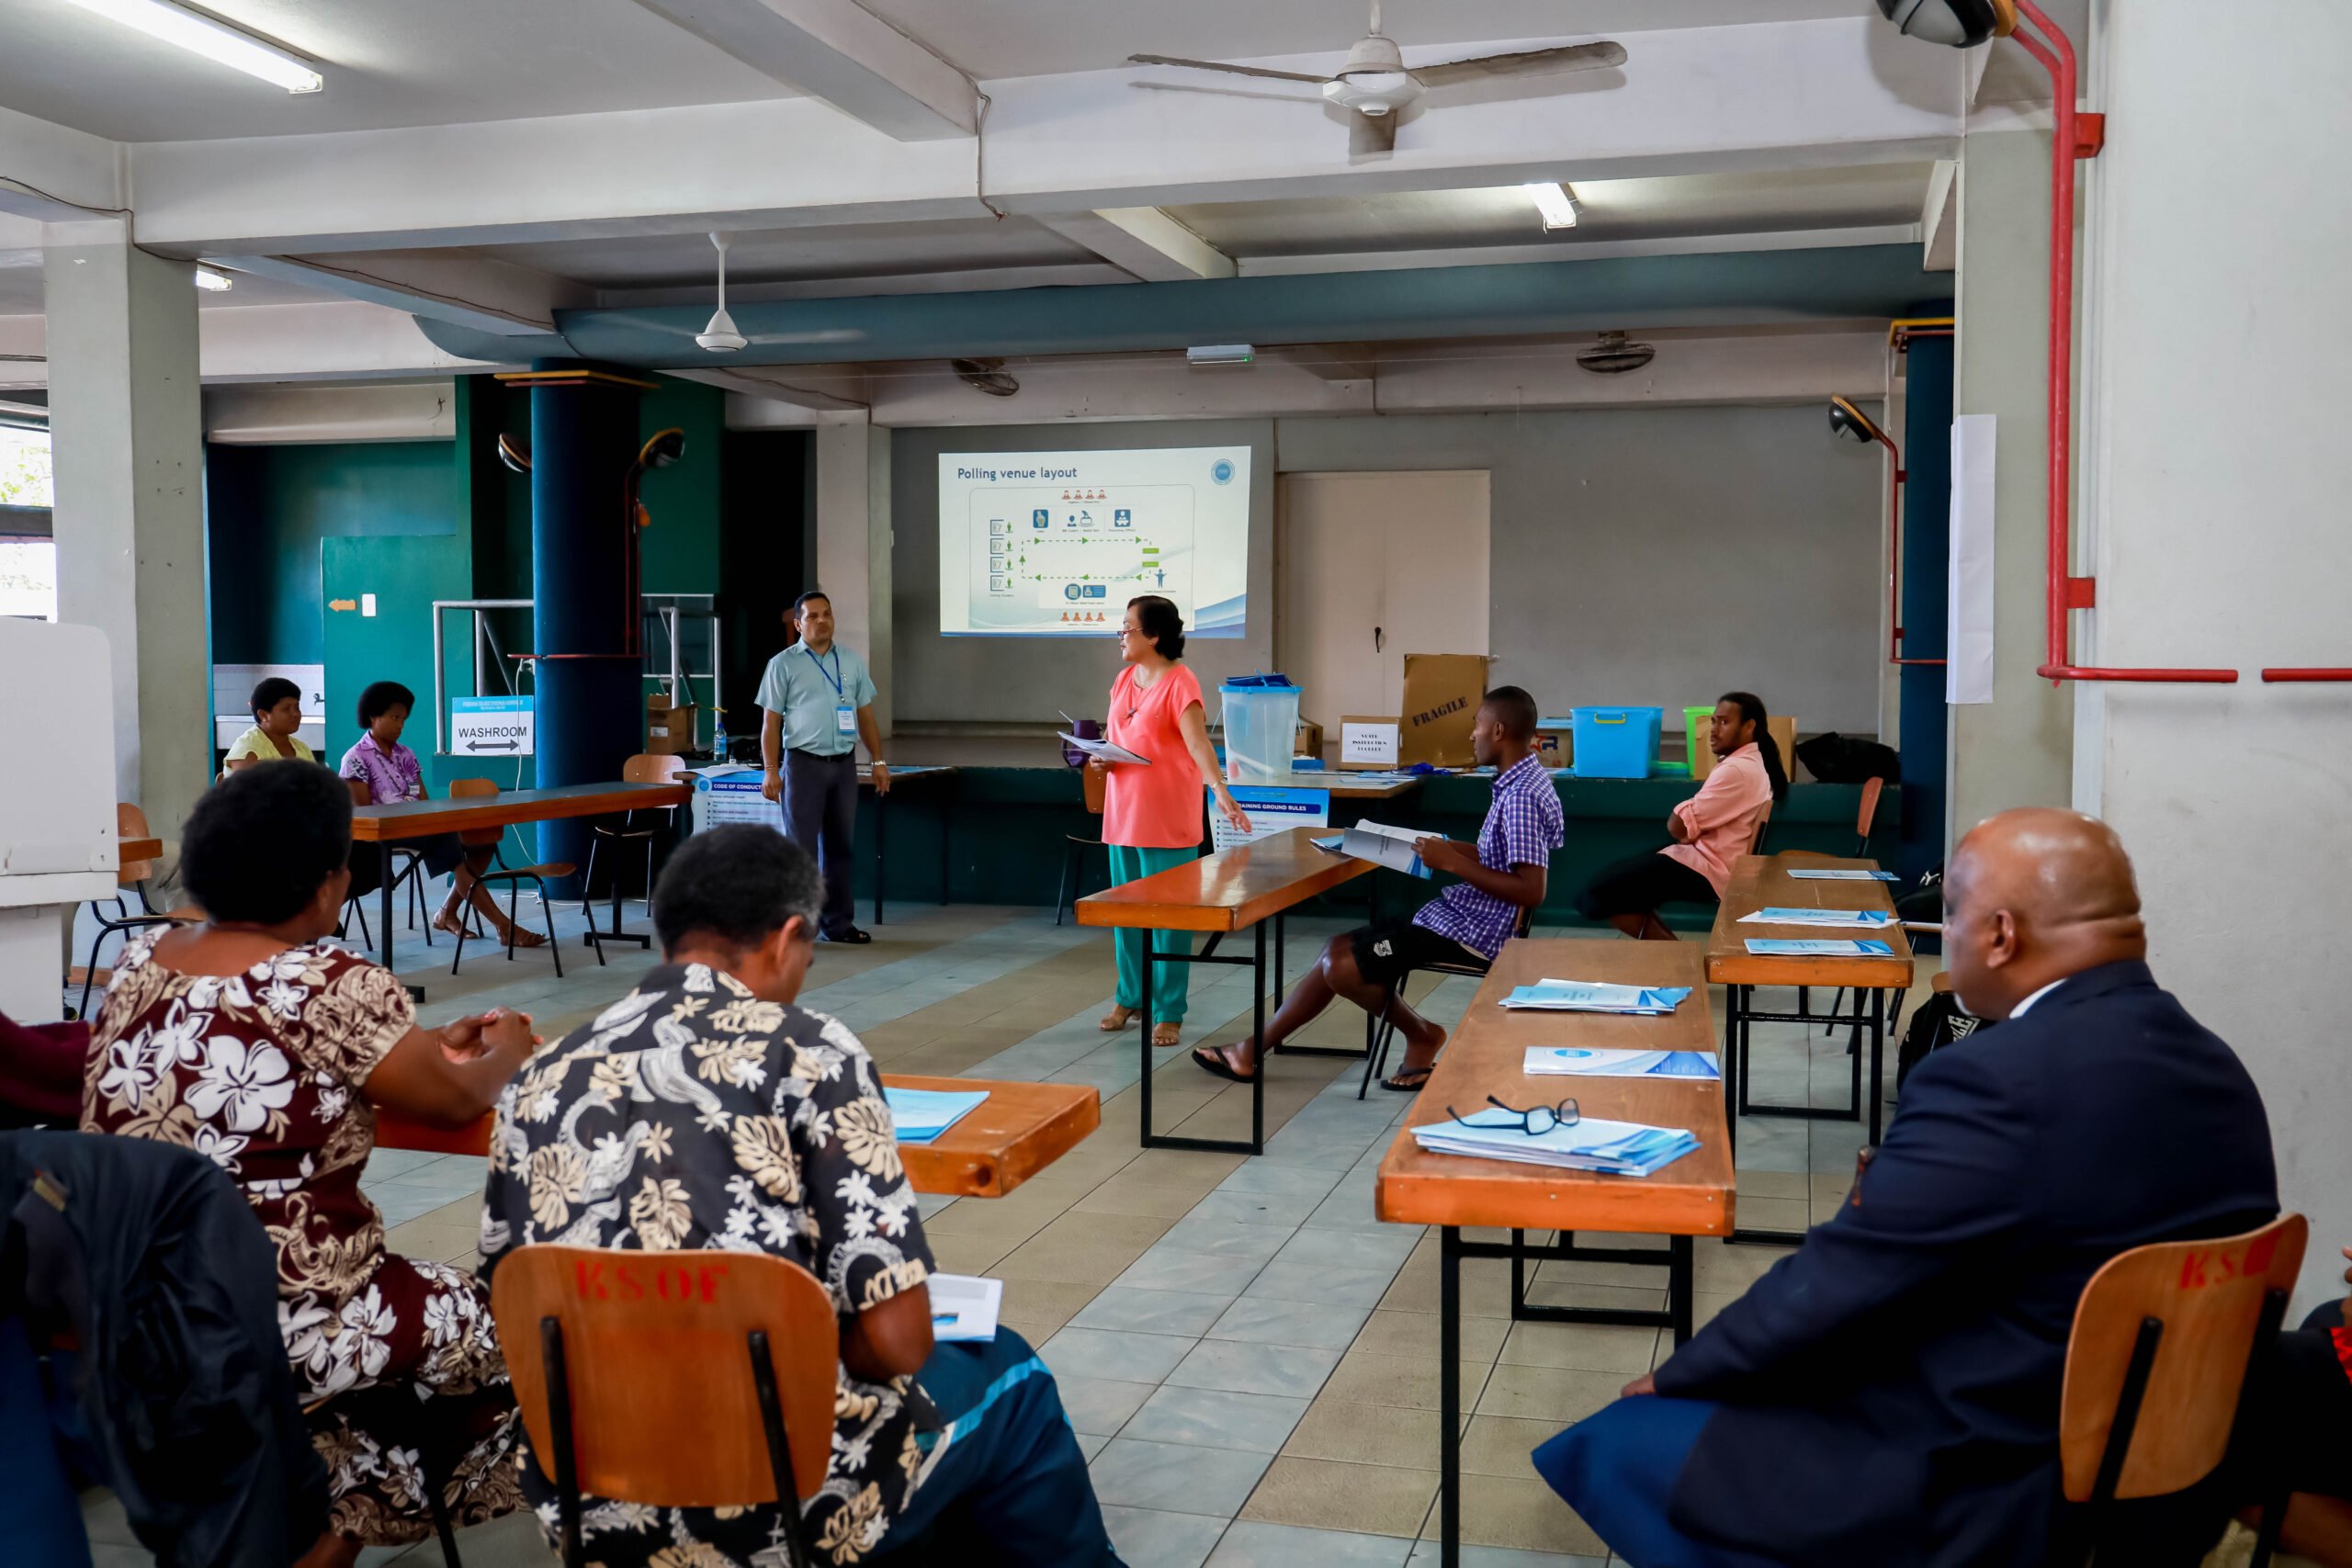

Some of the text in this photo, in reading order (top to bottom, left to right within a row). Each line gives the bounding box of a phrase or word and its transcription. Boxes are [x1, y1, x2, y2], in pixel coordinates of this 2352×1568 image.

[957, 467, 1078, 482] Polling venue layout
[1411, 695, 1469, 728] FRAGILE
[458, 726, 527, 739] WASHROOM
